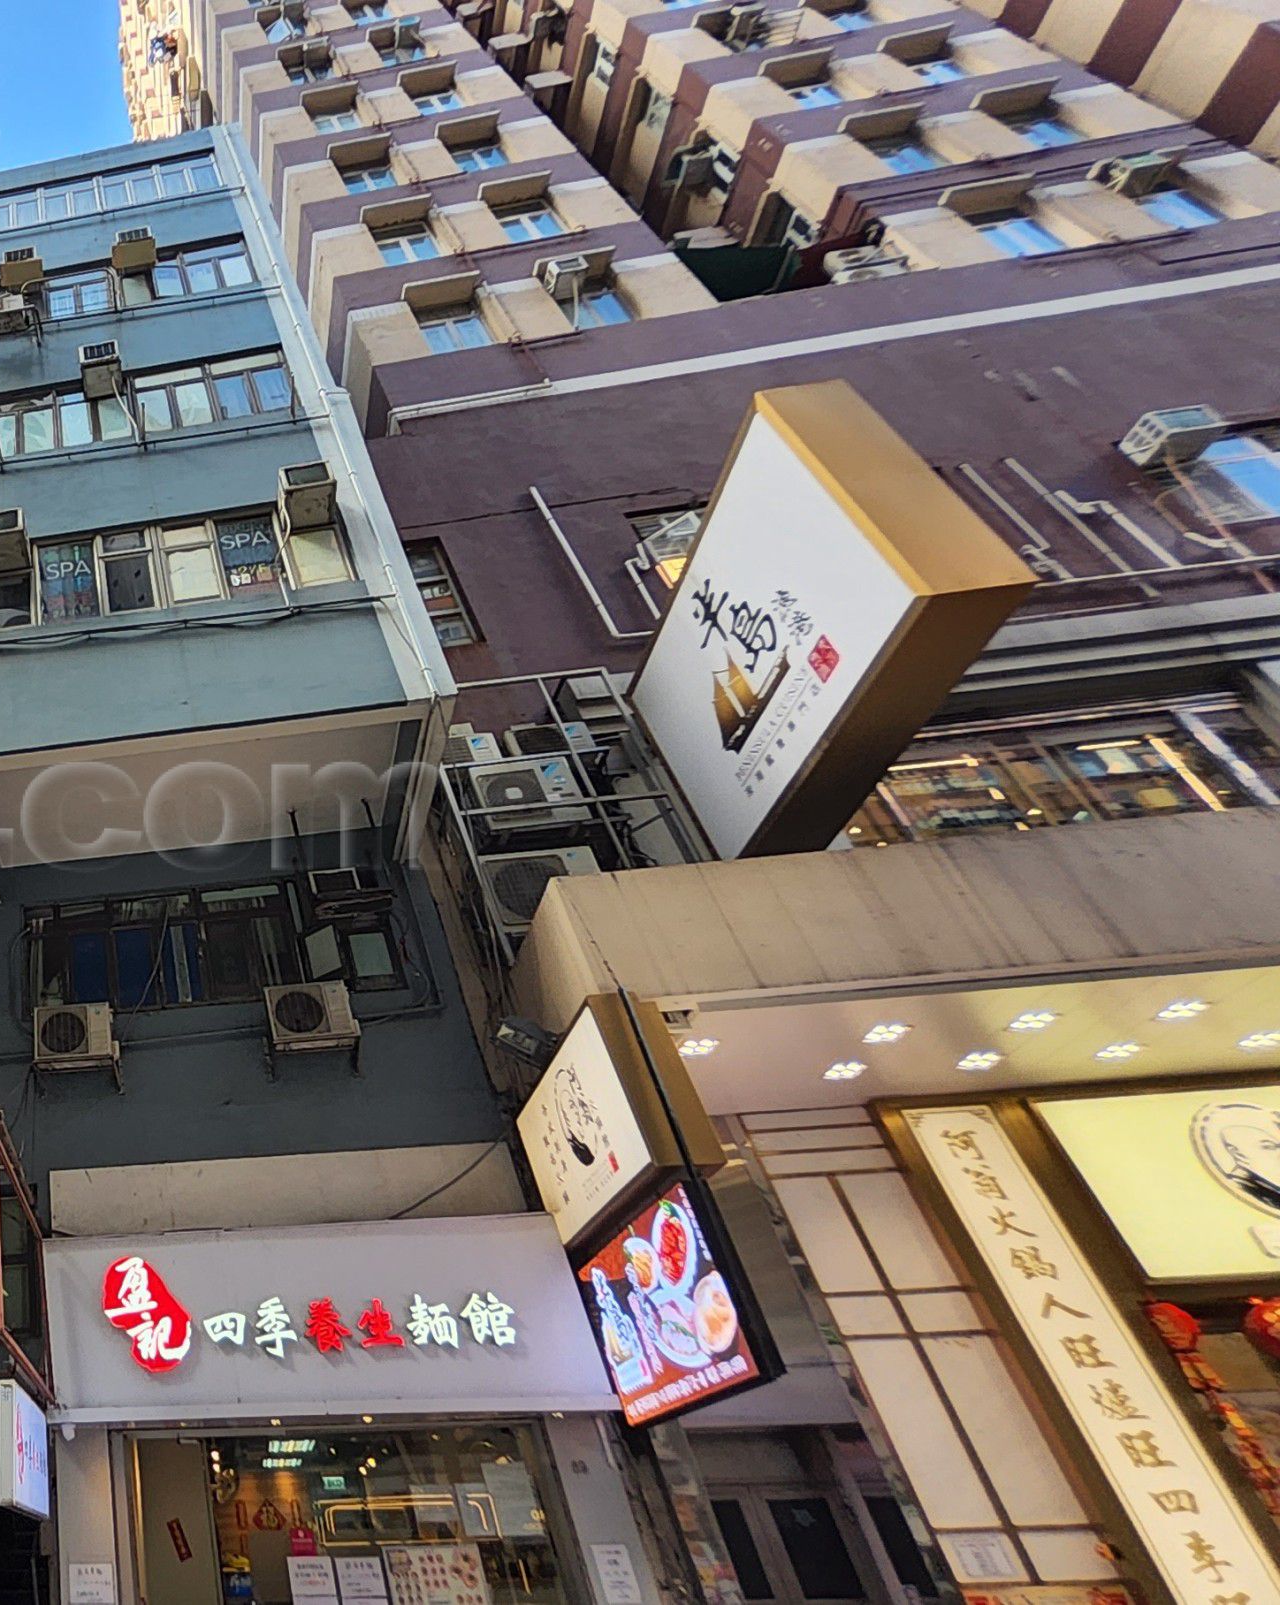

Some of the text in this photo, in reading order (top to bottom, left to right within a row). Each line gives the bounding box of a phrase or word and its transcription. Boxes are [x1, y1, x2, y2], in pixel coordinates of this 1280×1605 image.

[46, 560, 91, 580] SPA
[220, 531, 271, 550] SPA
[692, 579, 778, 673] 半島
[104, 1256, 191, 1363] 盈記
[203, 1290, 517, 1359] 四季養生麵館
